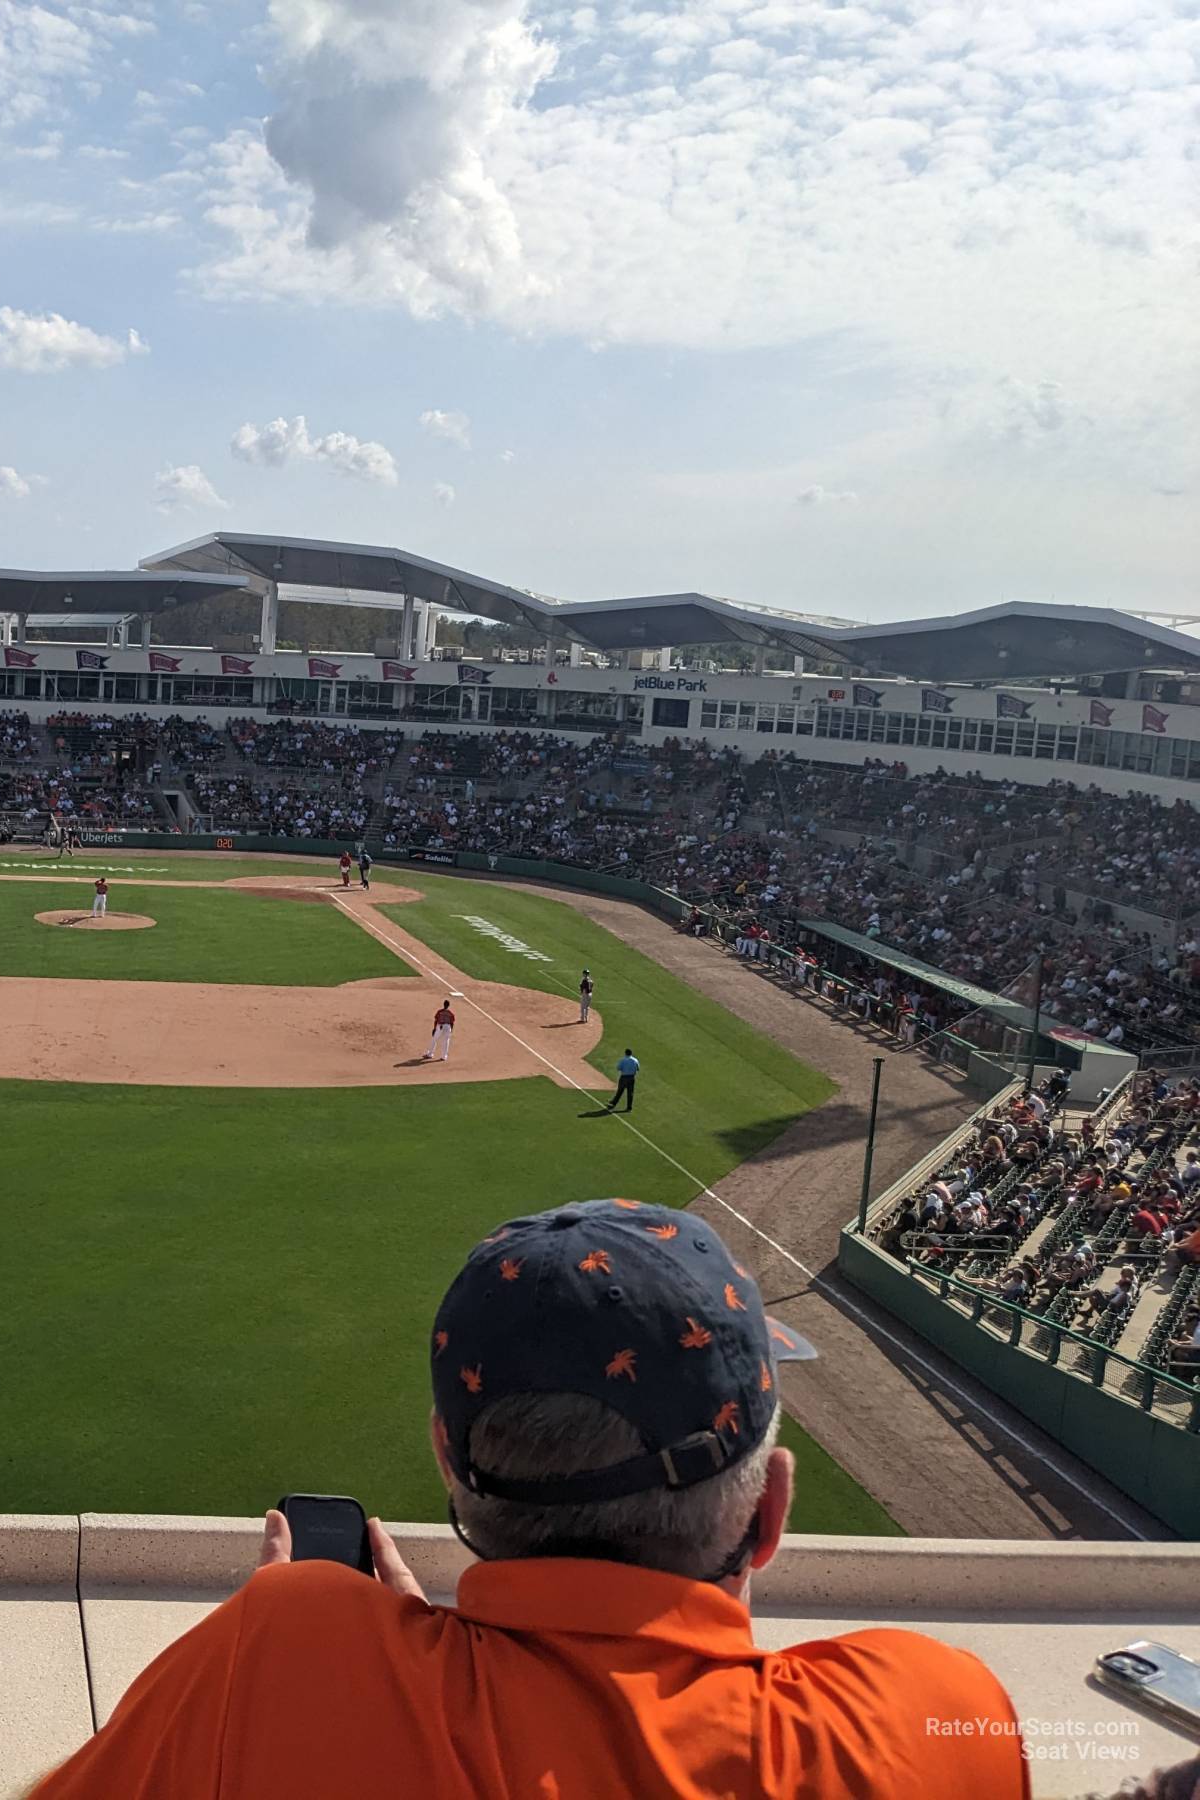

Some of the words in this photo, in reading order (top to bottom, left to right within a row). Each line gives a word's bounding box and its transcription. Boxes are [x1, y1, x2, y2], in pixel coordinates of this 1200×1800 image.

[633, 675, 675, 690] jetBlue
[677, 677, 708, 692] Park
[81, 832, 124, 844] UberJets
[424, 854, 453, 863] Safelite
